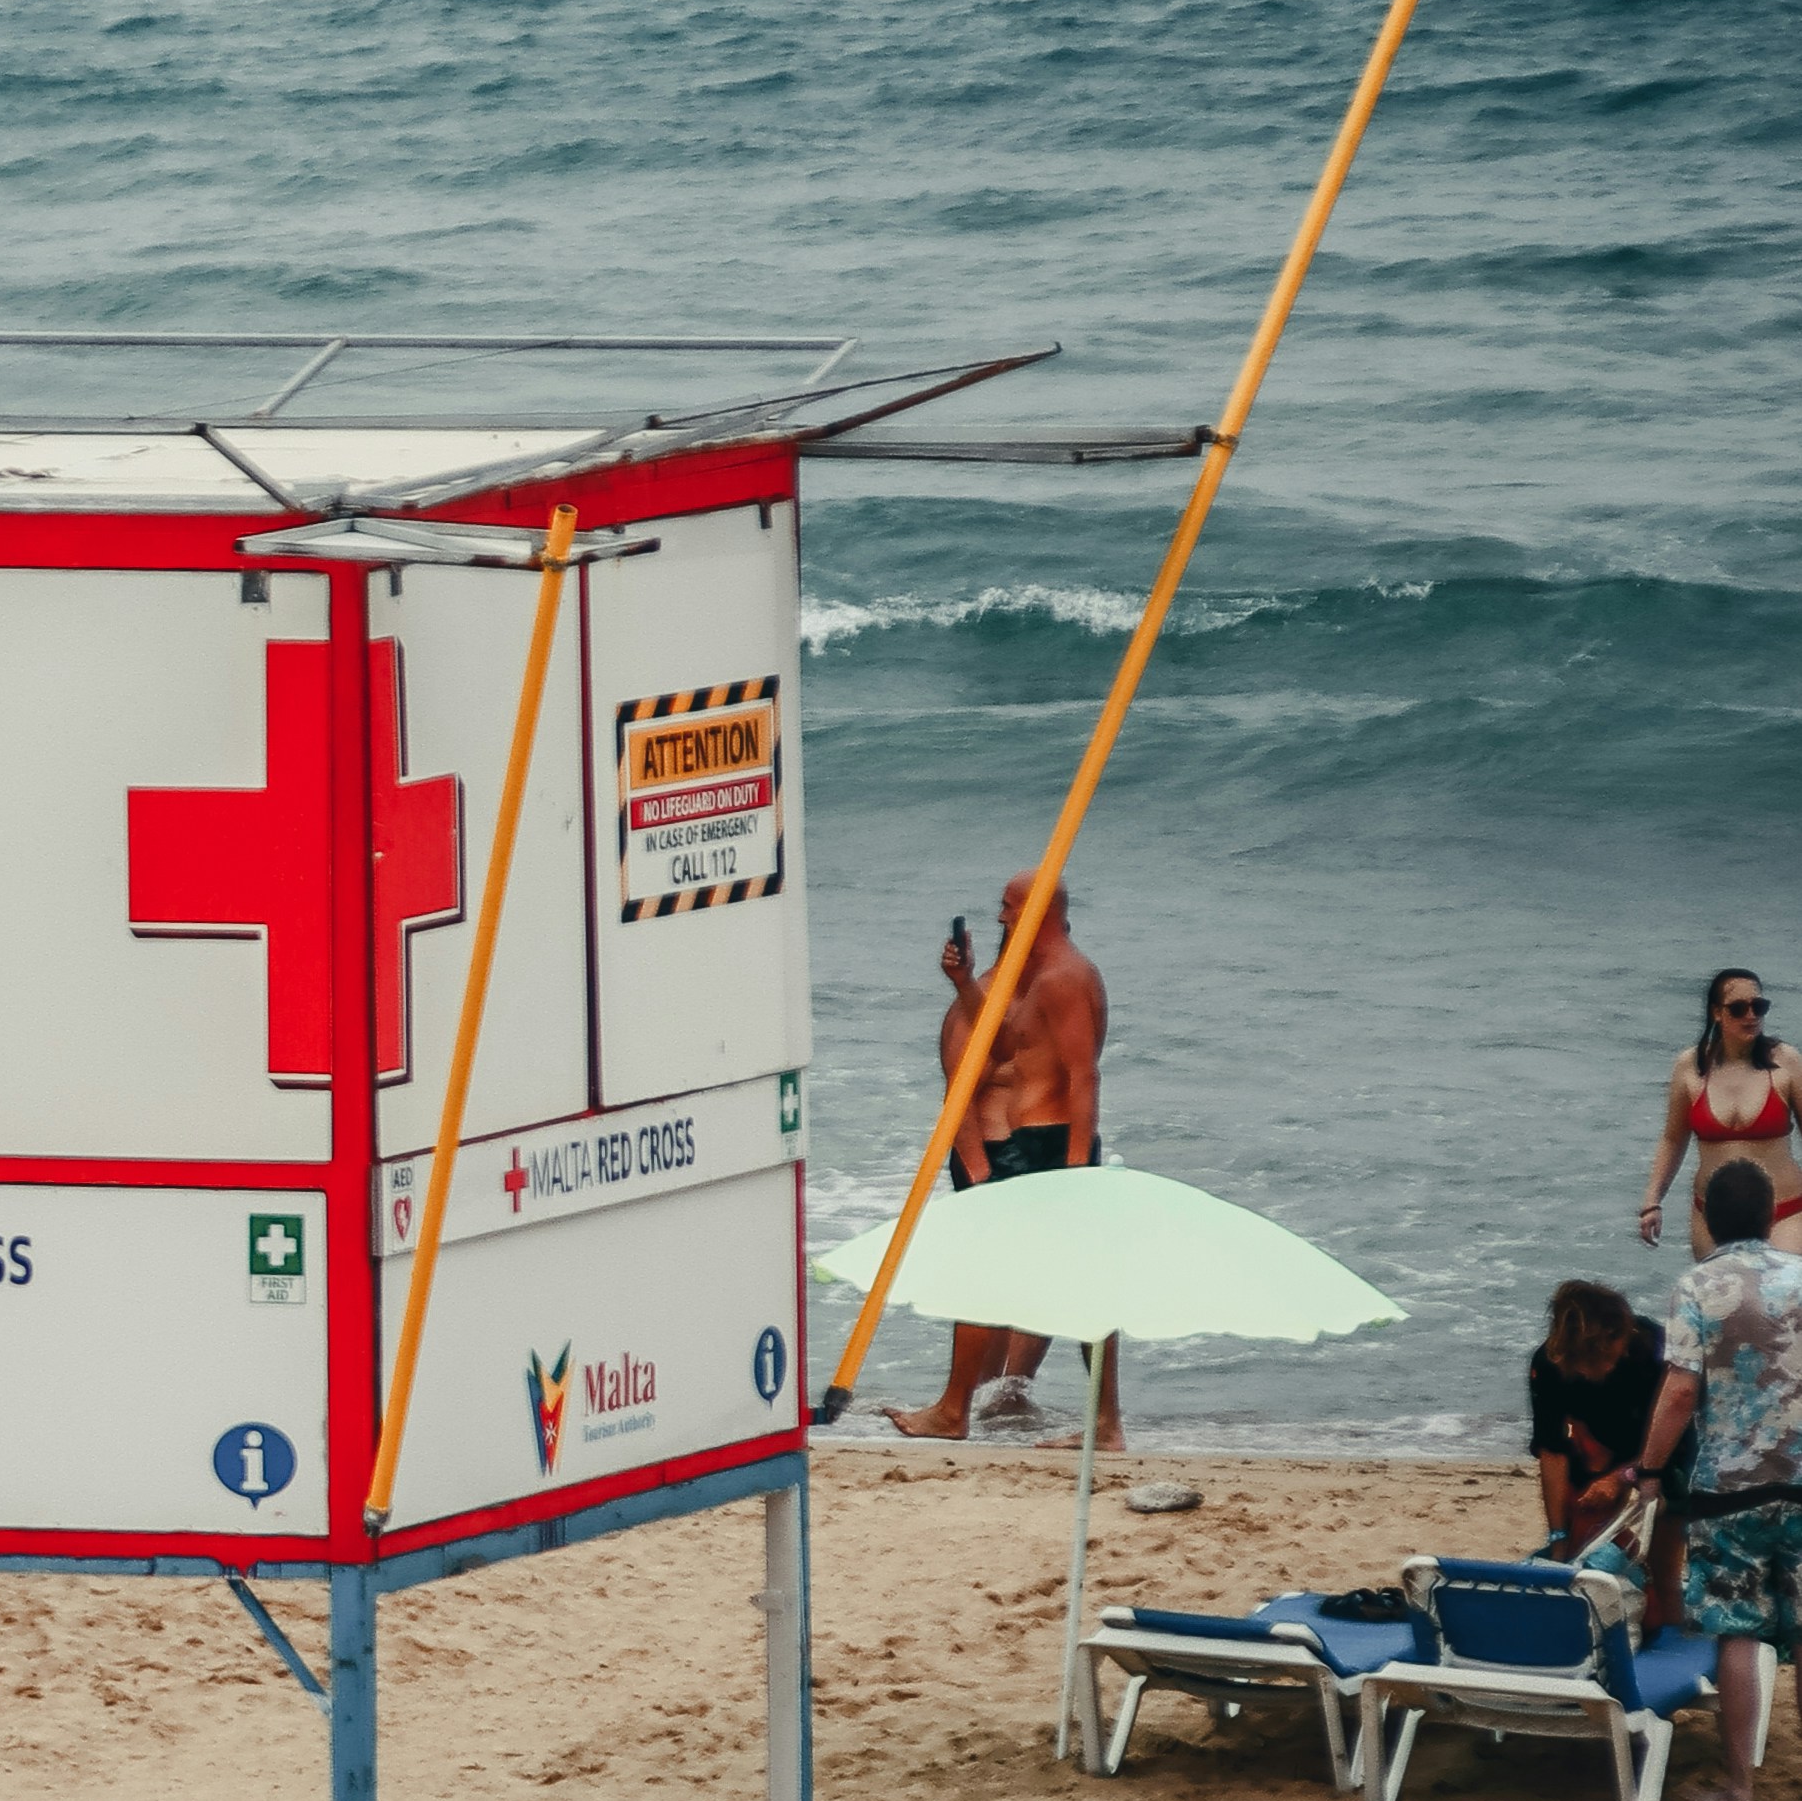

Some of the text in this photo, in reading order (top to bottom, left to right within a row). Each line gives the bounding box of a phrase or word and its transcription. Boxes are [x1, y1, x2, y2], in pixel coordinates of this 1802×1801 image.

[644, 719, 759, 780] ATTENTION
[643, 783, 760, 822] NO LIFEGUARD ON DUTY
[646, 813, 759, 852] IN CASE OF EMERGENCY
[672, 848, 737, 884] CALL 112
[393, 1166, 413, 1188] AED
[532, 1116, 696, 1199] MALTA RED CROSS
[261, 1277, 295, 1289] FIRST
[267, 1289, 289, 1300] AID
[584, 1351, 657, 1417] Malta
